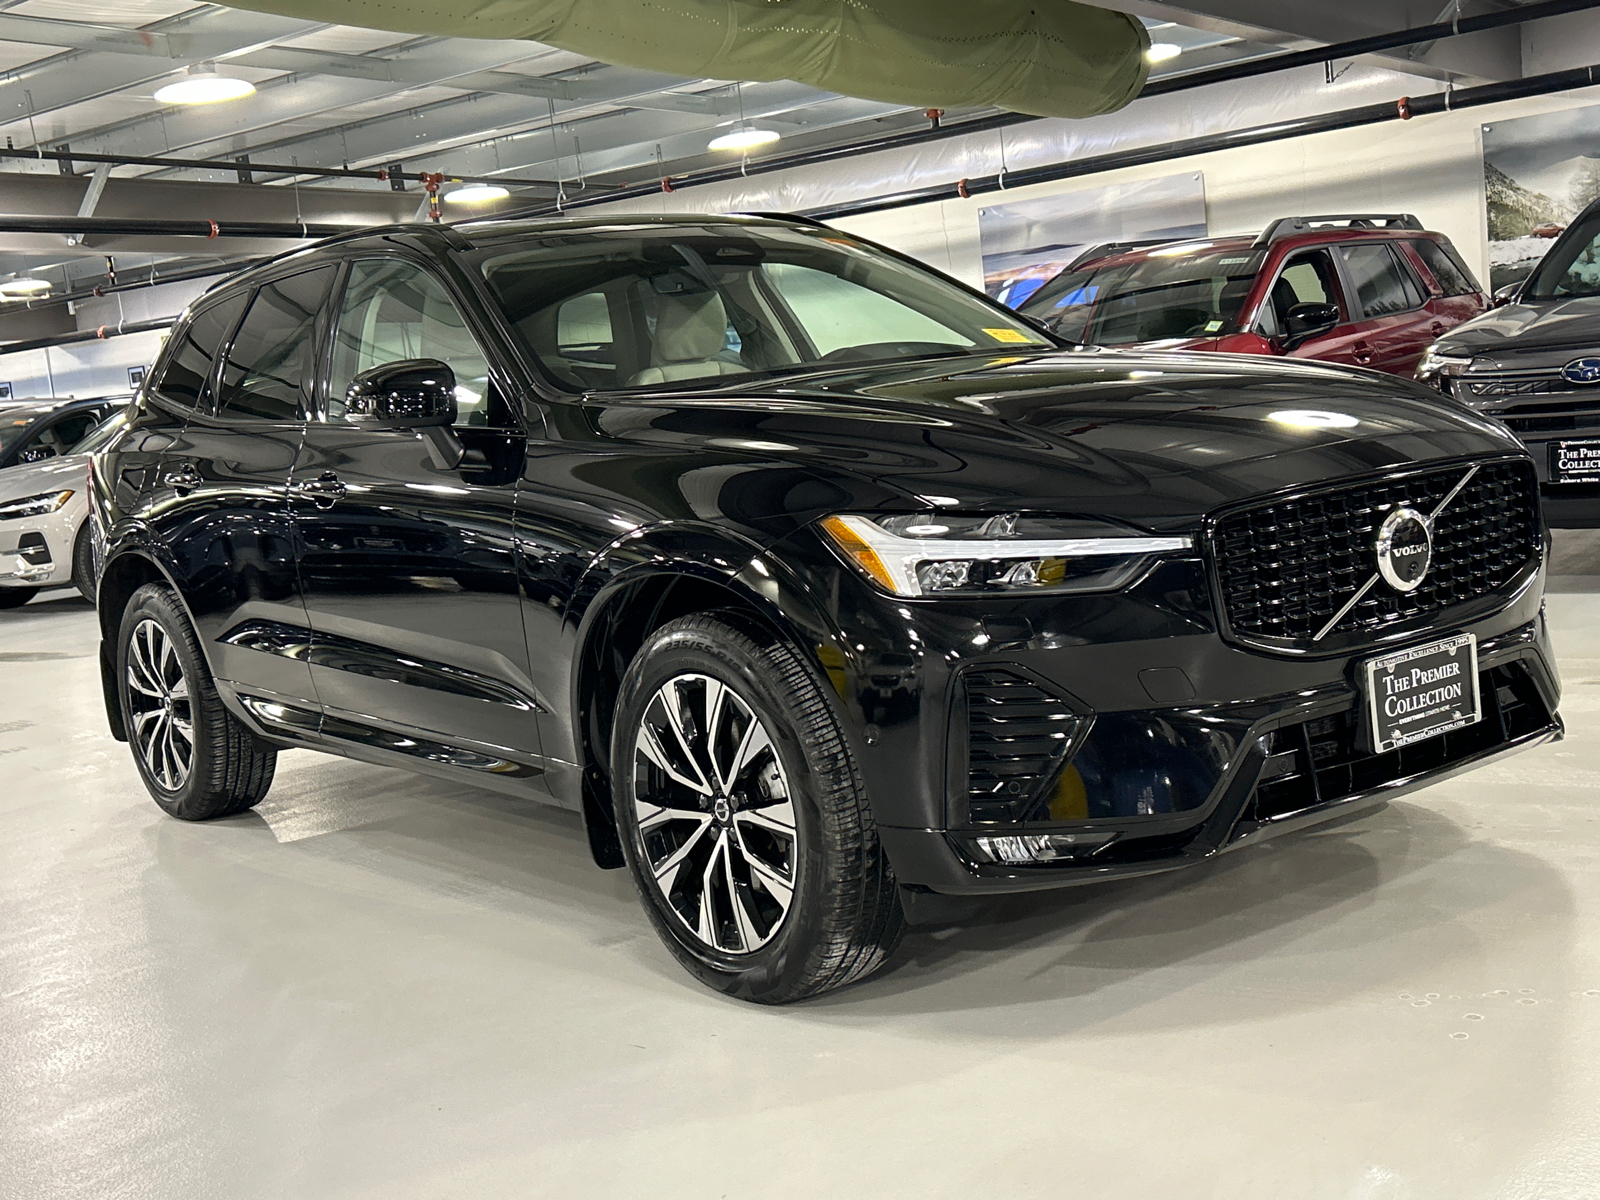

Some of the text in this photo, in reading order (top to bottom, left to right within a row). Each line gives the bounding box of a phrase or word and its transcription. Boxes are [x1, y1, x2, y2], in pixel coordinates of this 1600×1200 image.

[1392, 542, 1428, 558] VOLVO
[1382, 662, 1461, 696] THE PREMIER
[1384, 682, 1462, 718] COLLECTION
